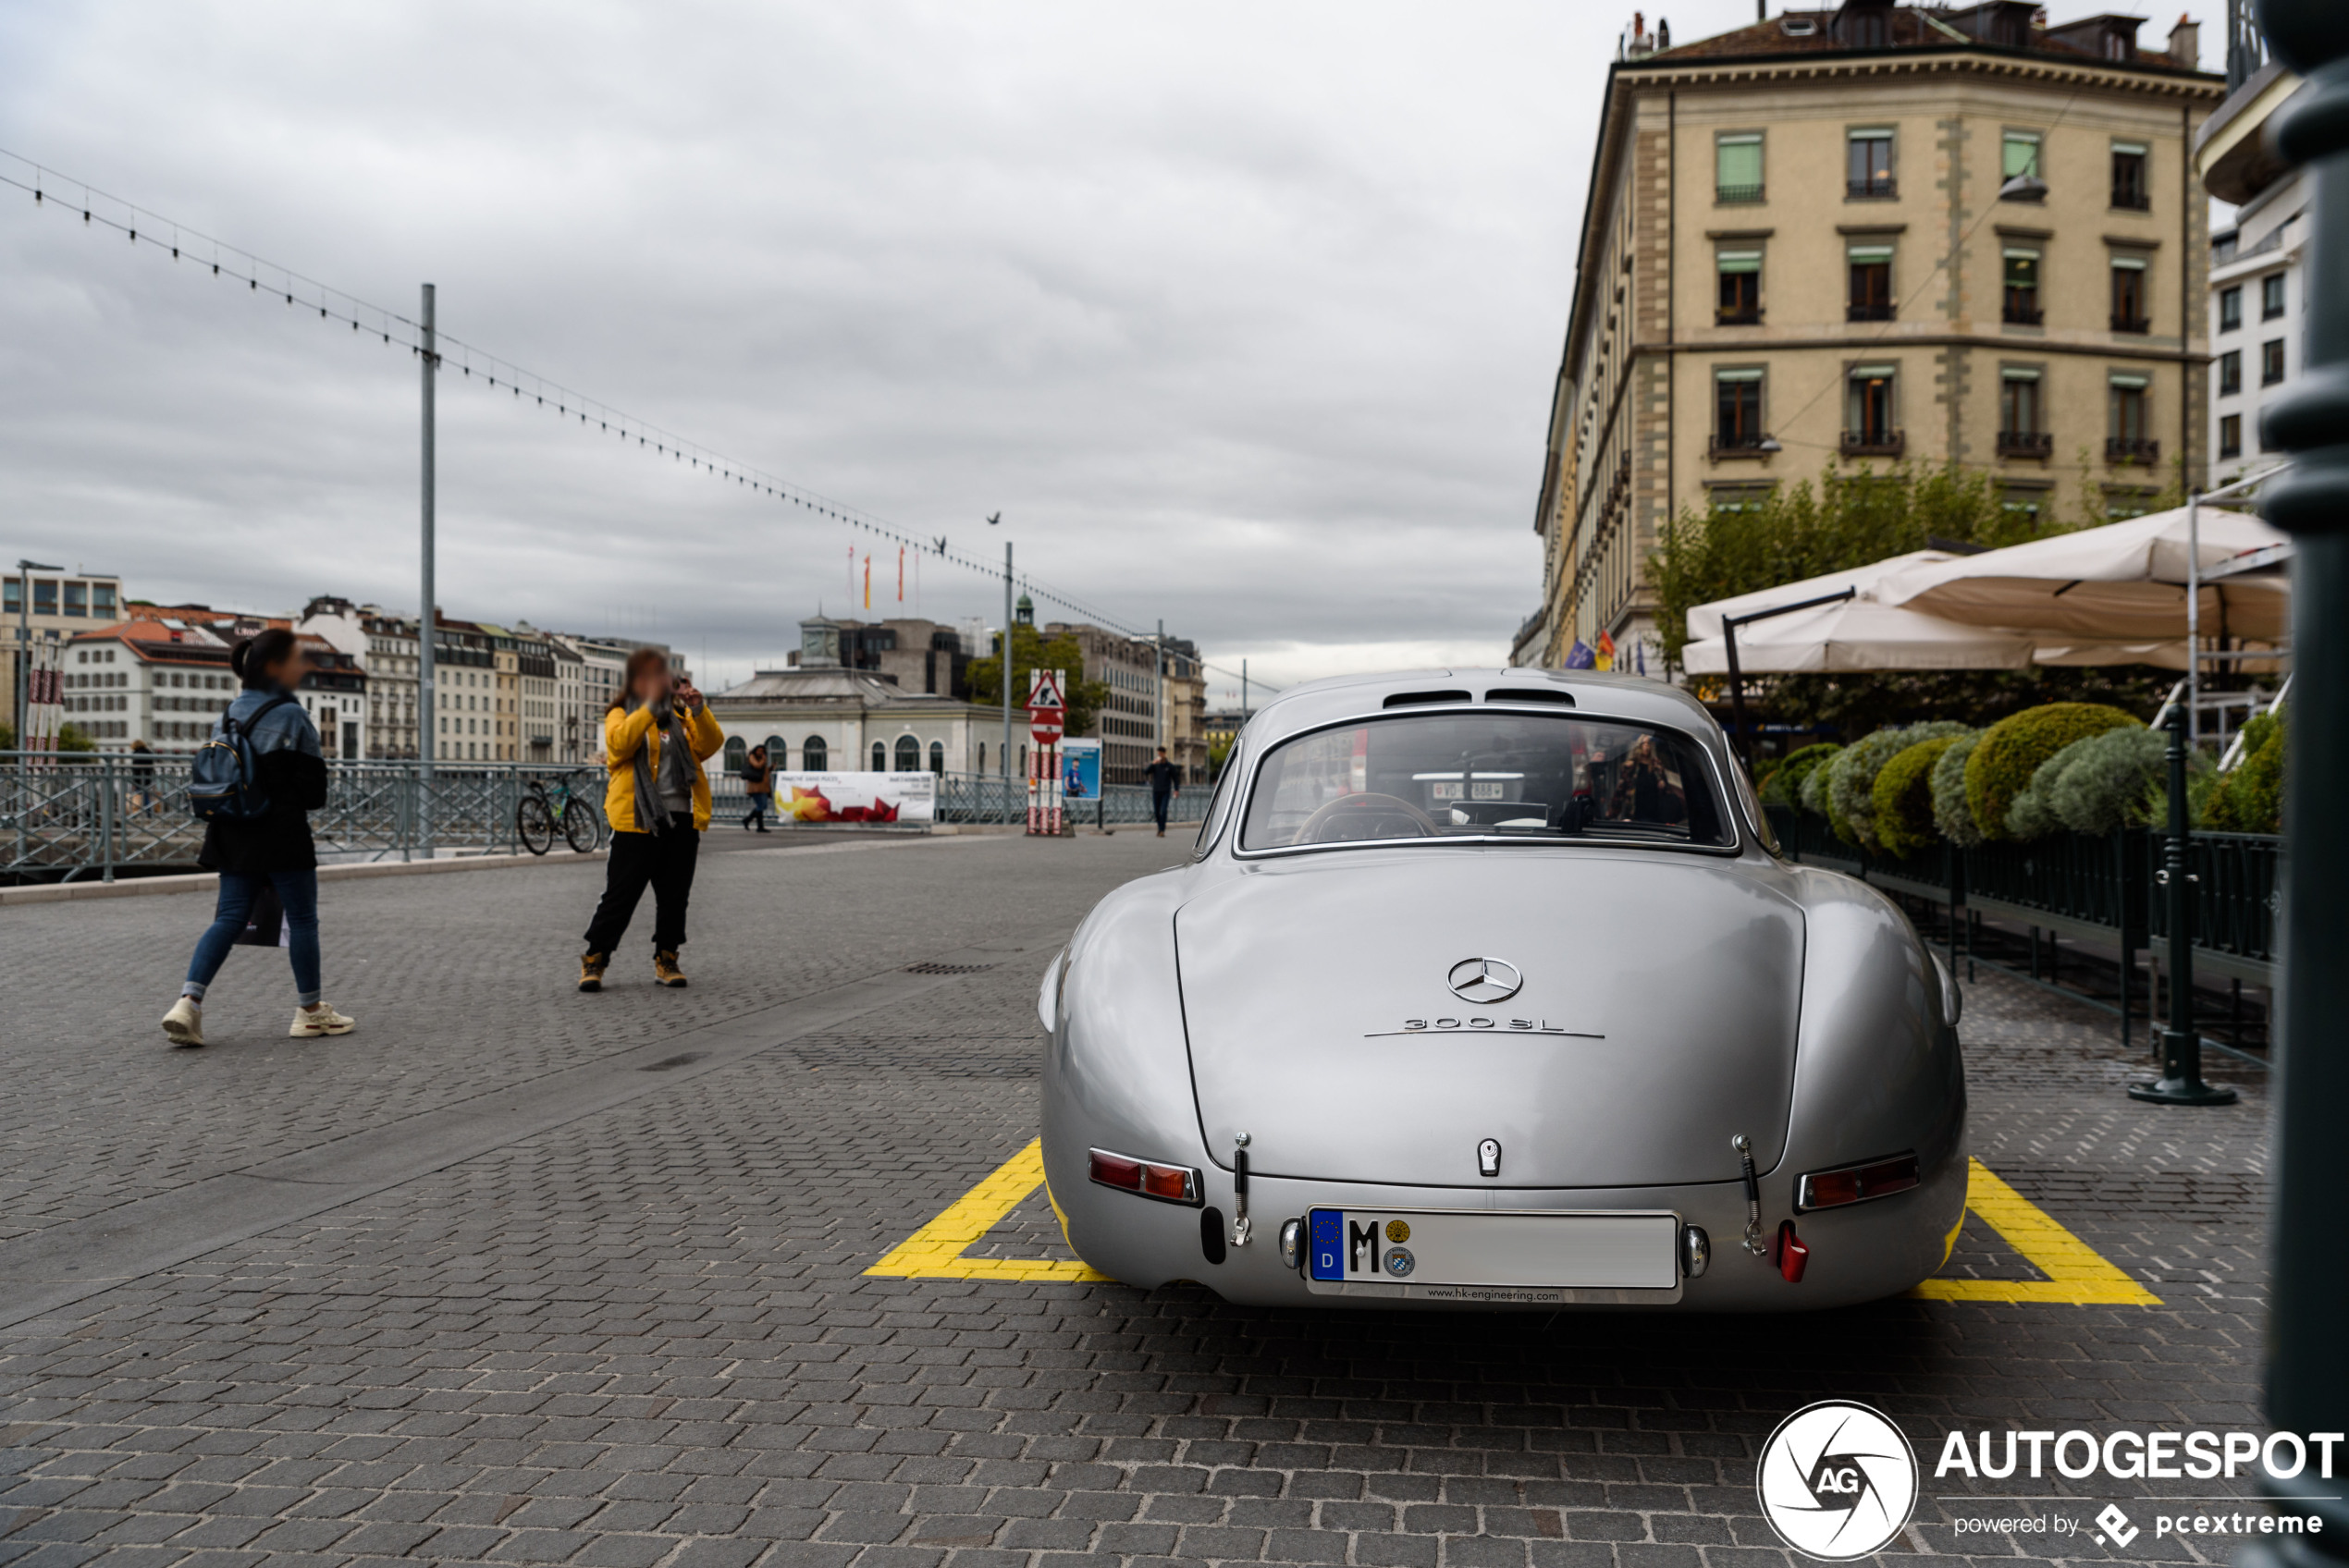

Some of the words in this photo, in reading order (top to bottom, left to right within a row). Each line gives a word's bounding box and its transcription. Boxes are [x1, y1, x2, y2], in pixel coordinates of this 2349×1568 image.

[1404, 1017, 1495, 1030] 300
[1508, 1018, 1565, 1031] SL
[1349, 1219, 1379, 1273] M
[1322, 1253, 1334, 1268] D
[1428, 1288, 1559, 1302] www.hk-engineering.com
